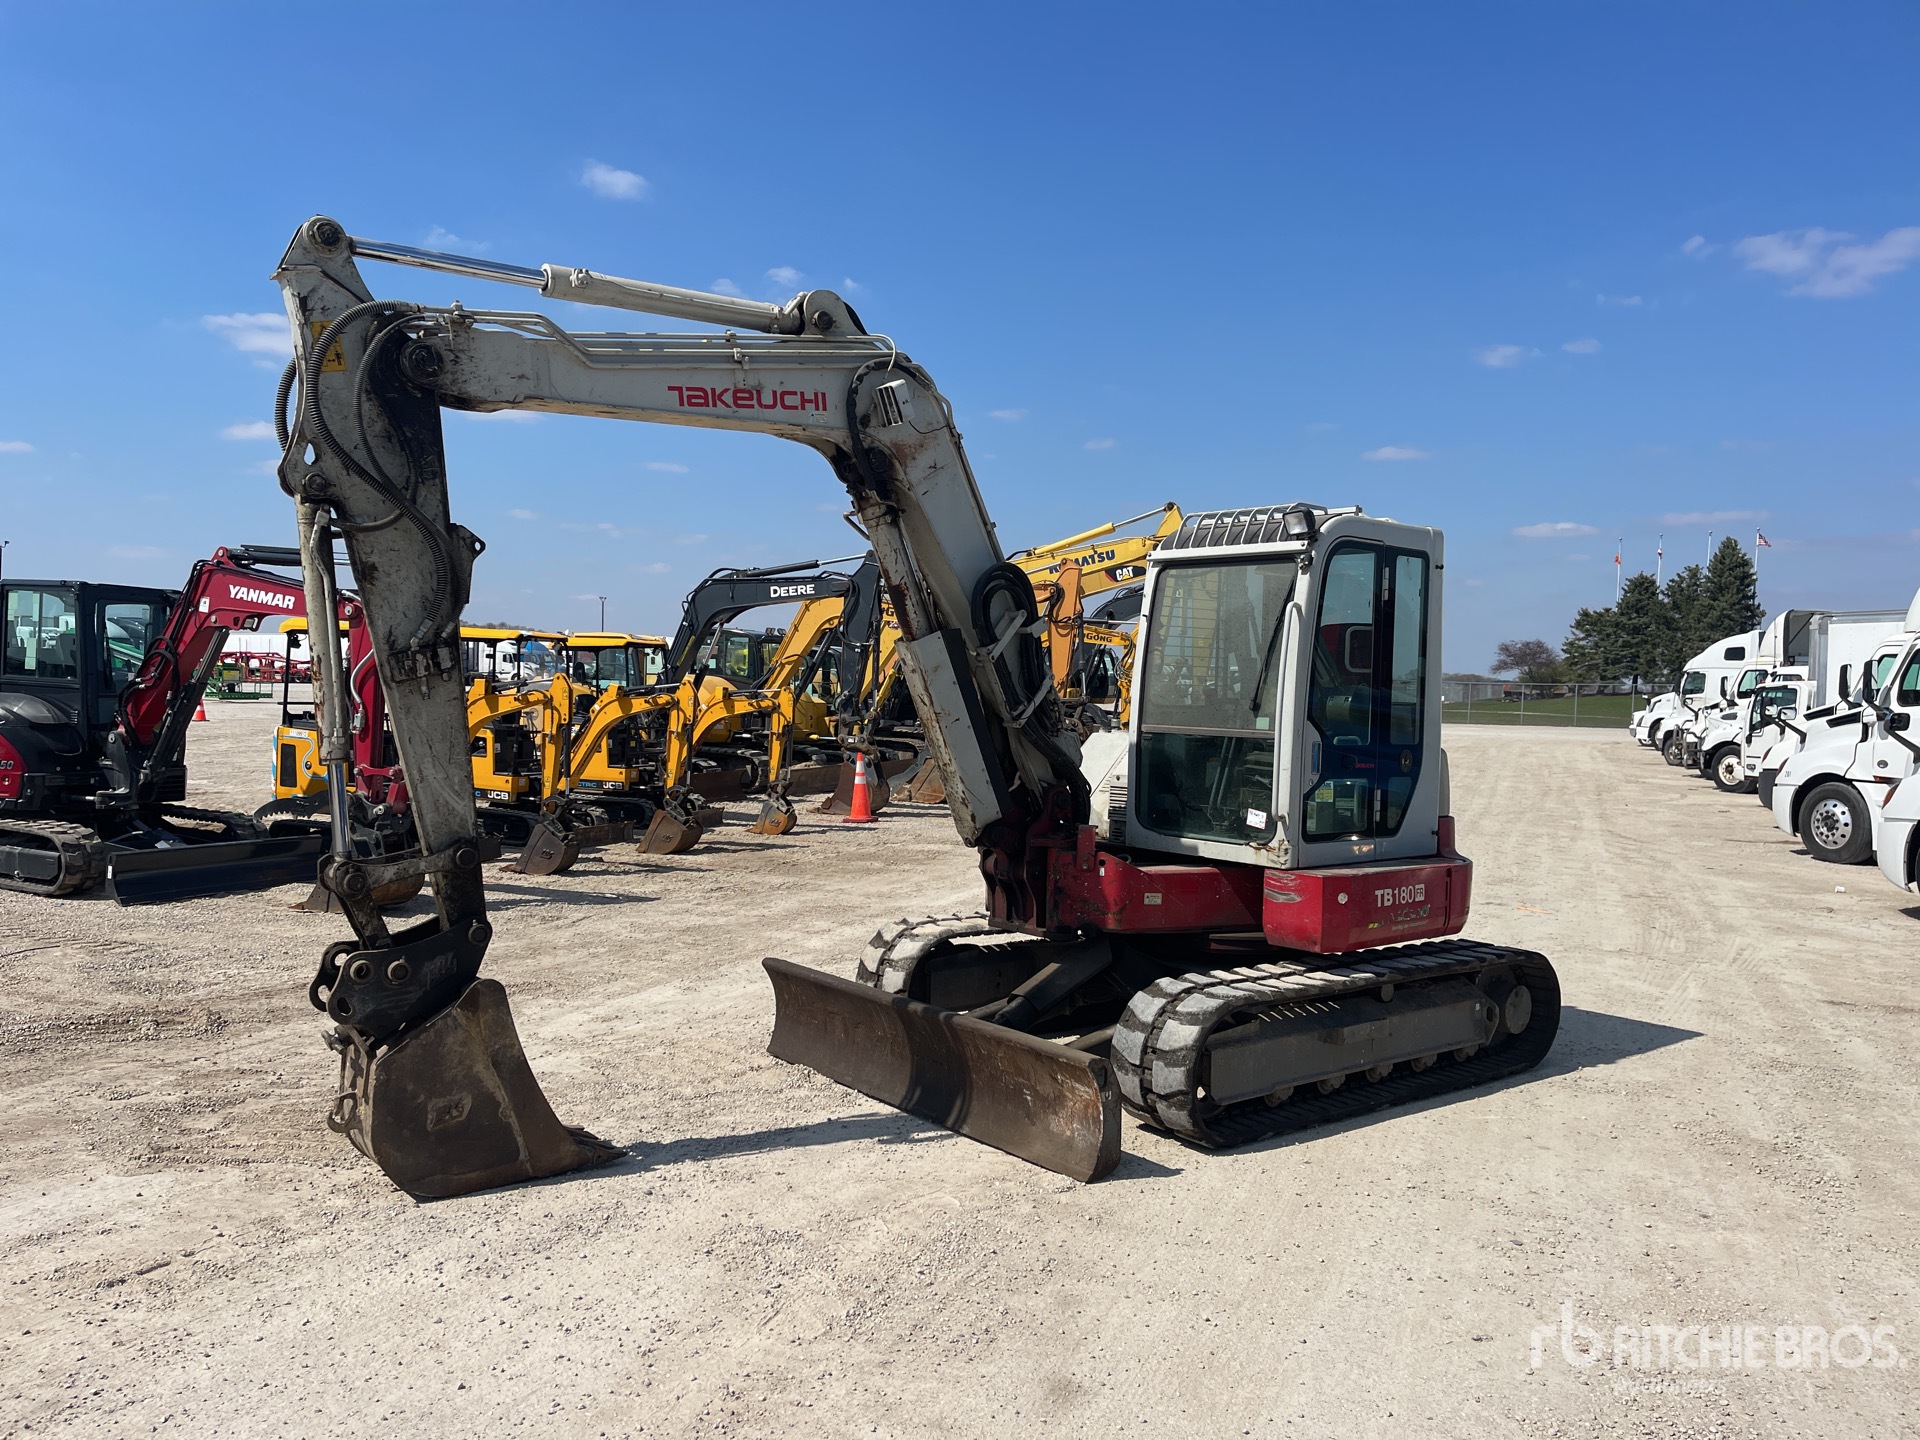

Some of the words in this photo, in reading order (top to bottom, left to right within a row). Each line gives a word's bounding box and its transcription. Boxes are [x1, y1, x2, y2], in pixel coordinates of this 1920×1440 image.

[1115, 566, 1134, 581] CAT
[229, 584, 295, 610] YANMAR
[770, 583, 816, 598] DEERE
[1084, 632, 1113, 643] GONG
[602, 781, 623, 790] JCB
[487, 790, 509, 800] JCB
